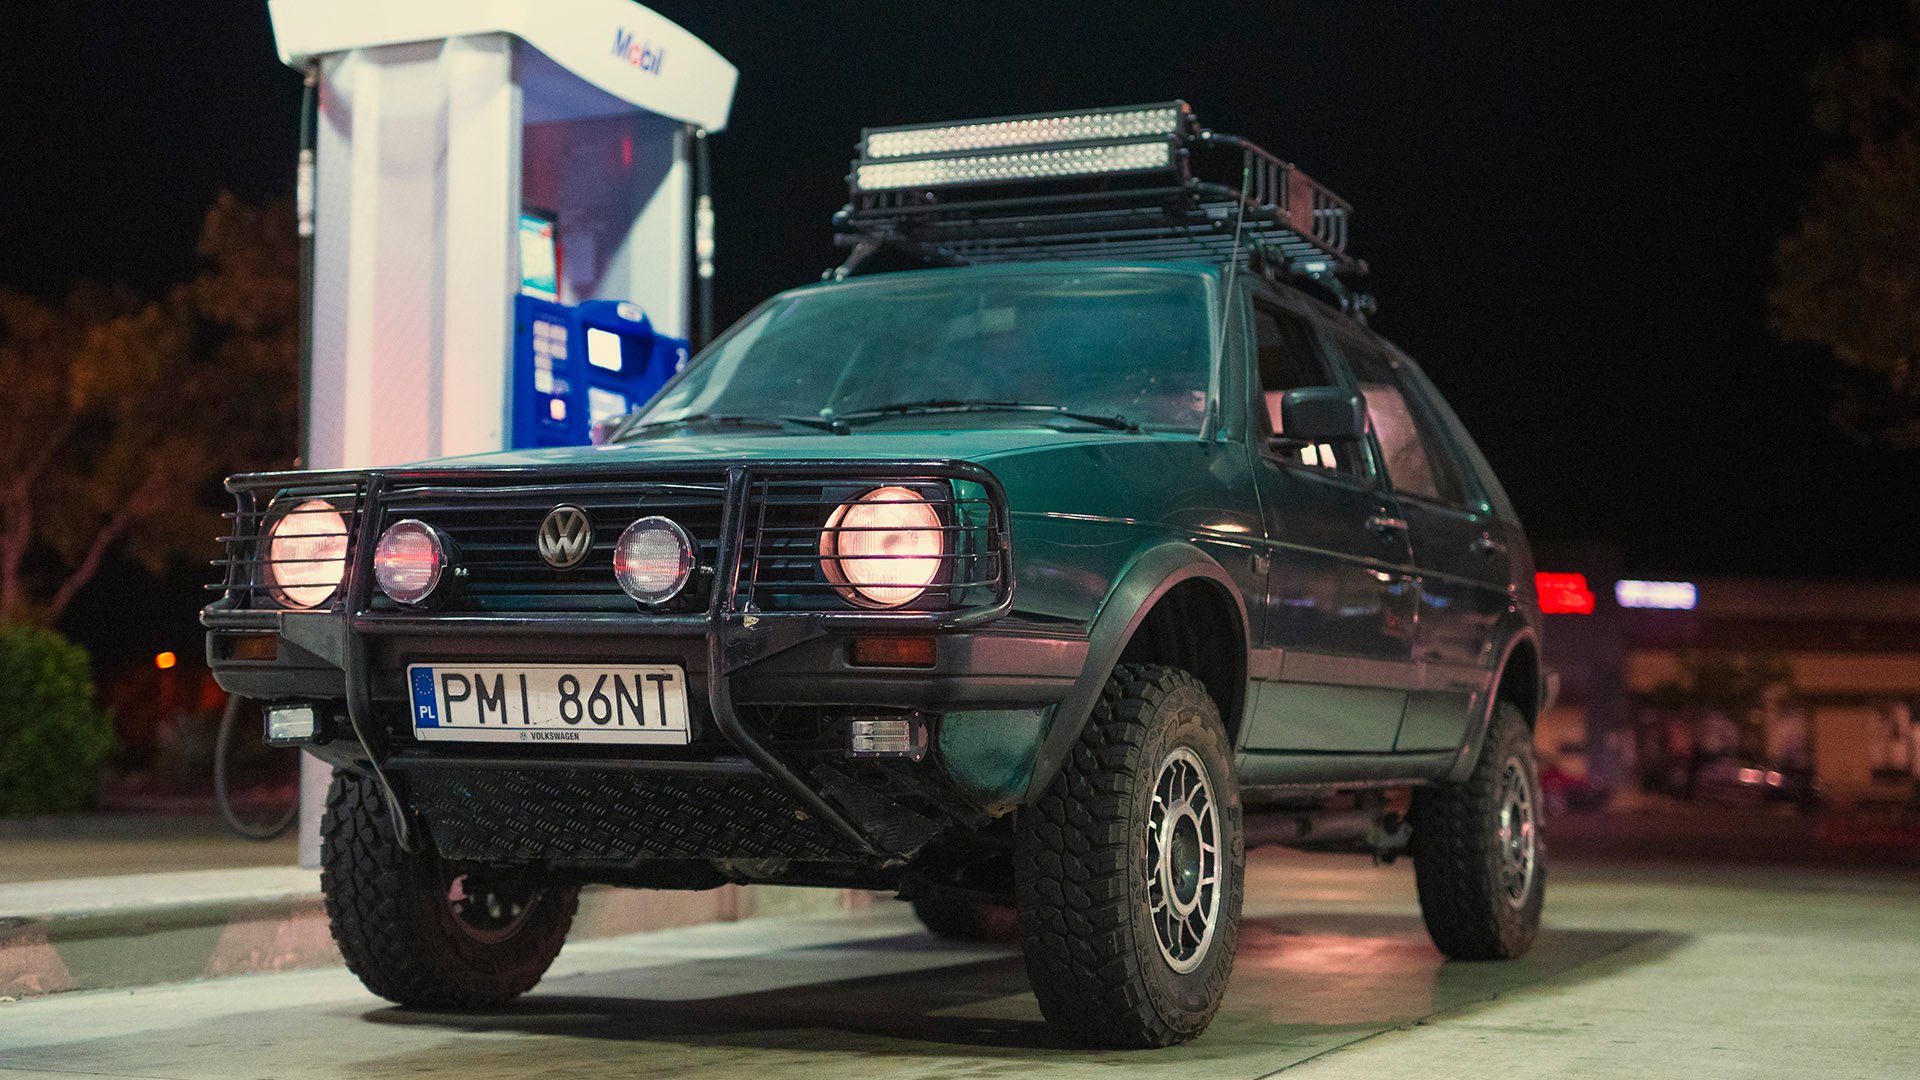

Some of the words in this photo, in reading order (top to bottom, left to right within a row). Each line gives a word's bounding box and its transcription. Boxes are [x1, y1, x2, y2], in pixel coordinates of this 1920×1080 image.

[612, 28, 664, 76] Mobil
[420, 706, 436, 719] PL
[441, 673, 530, 725] PMI
[558, 674, 673, 726] 86NT
[531, 732, 579, 741] VOLKSWAGEN
